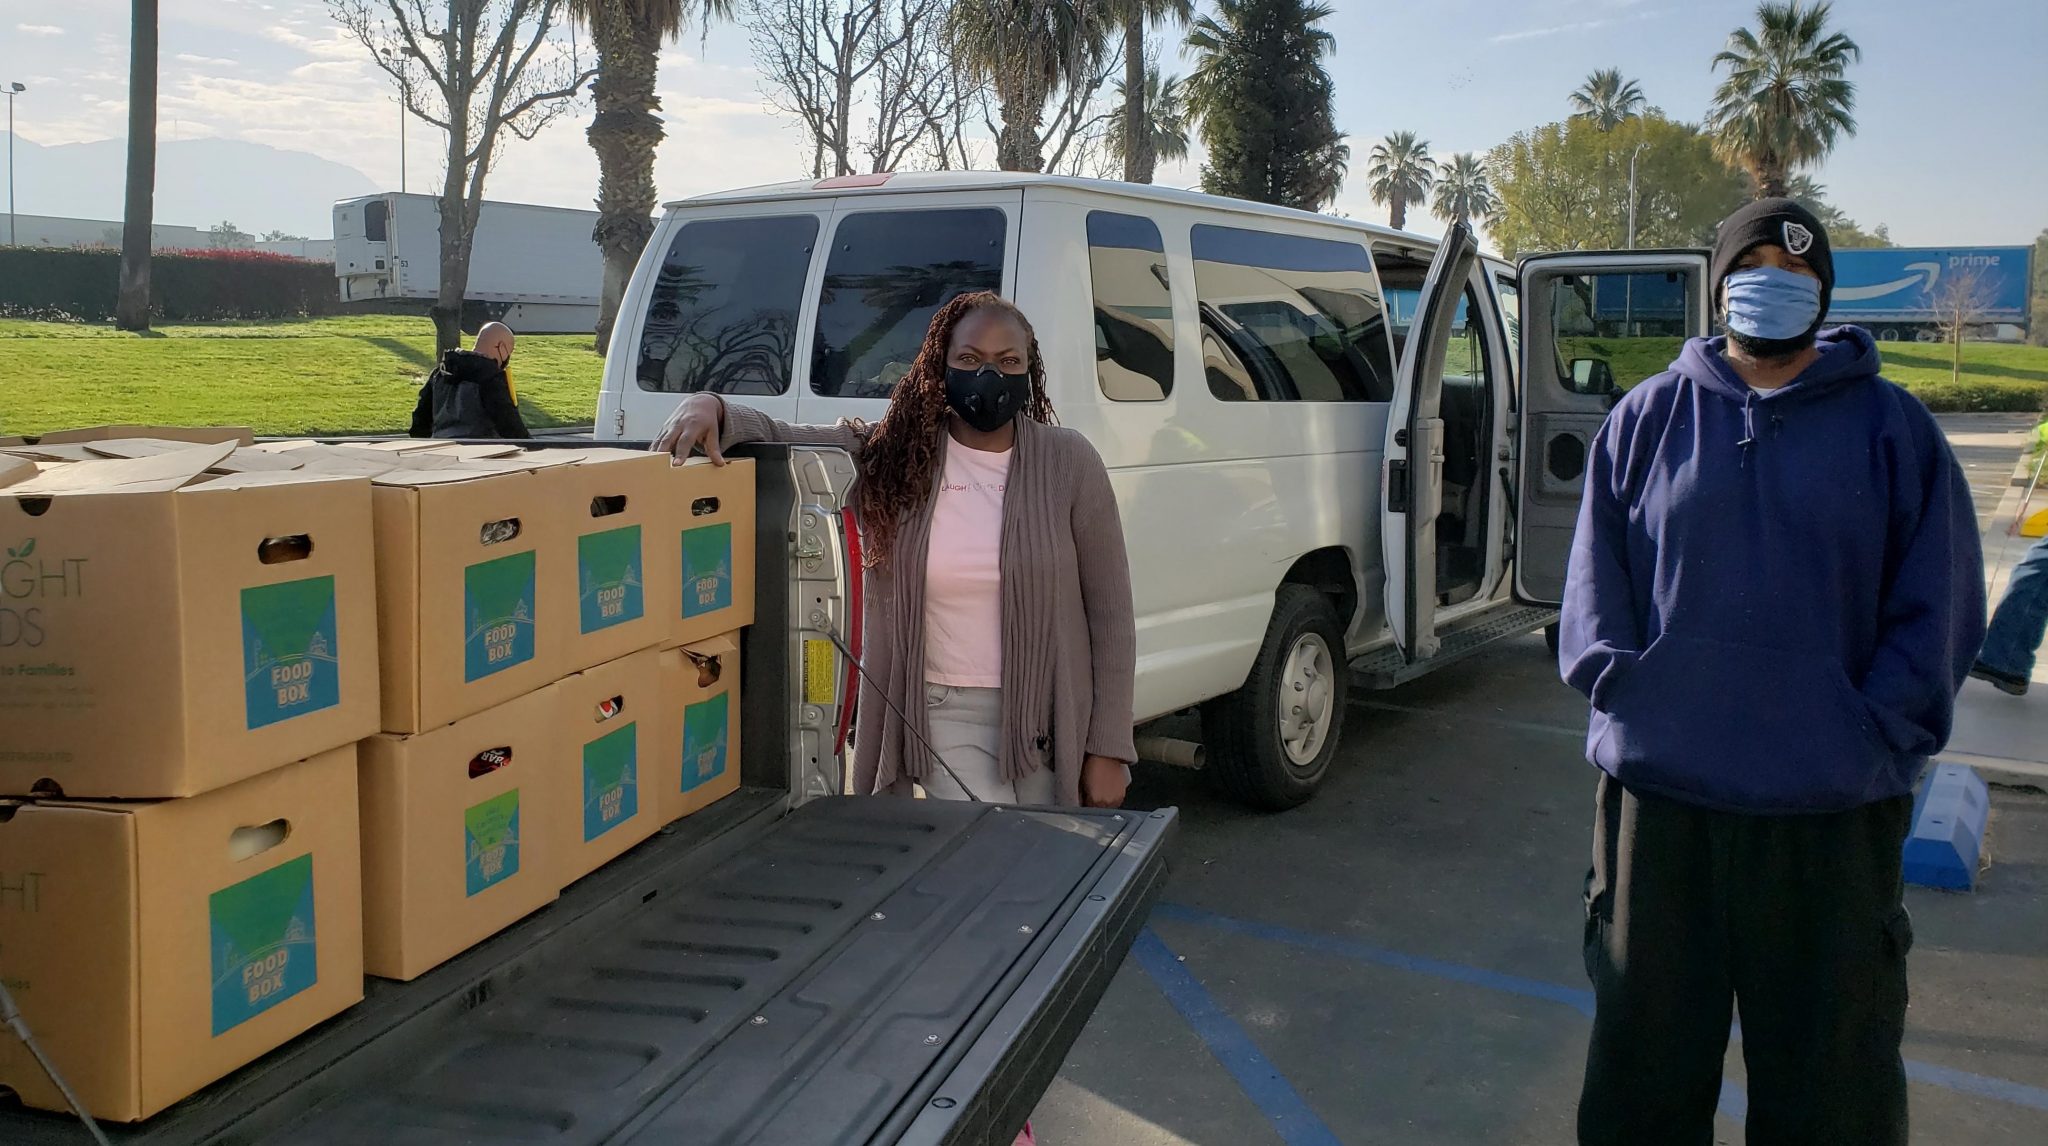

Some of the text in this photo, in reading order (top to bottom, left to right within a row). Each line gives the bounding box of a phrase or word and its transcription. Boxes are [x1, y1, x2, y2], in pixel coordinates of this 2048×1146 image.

[401, 260, 409, 268] 53
[1949, 253, 2001, 269] prime
[696, 577, 718, 593] FOOD
[597, 586, 625, 603] FOOD
[698, 591, 716, 605] BOX
[601, 601, 623, 617] BOX
[484, 623, 517, 646] FOOD
[488, 643, 513, 663] BOX
[272, 660, 313, 684] FOOD
[278, 682, 310, 706] BOX
[480, 751, 505, 764] BAR
[599, 786, 623, 810] FOOD
[602, 804, 621, 822] BOX
[243, 949, 288, 985] FOOD
[249, 972, 284, 1003] BOX
